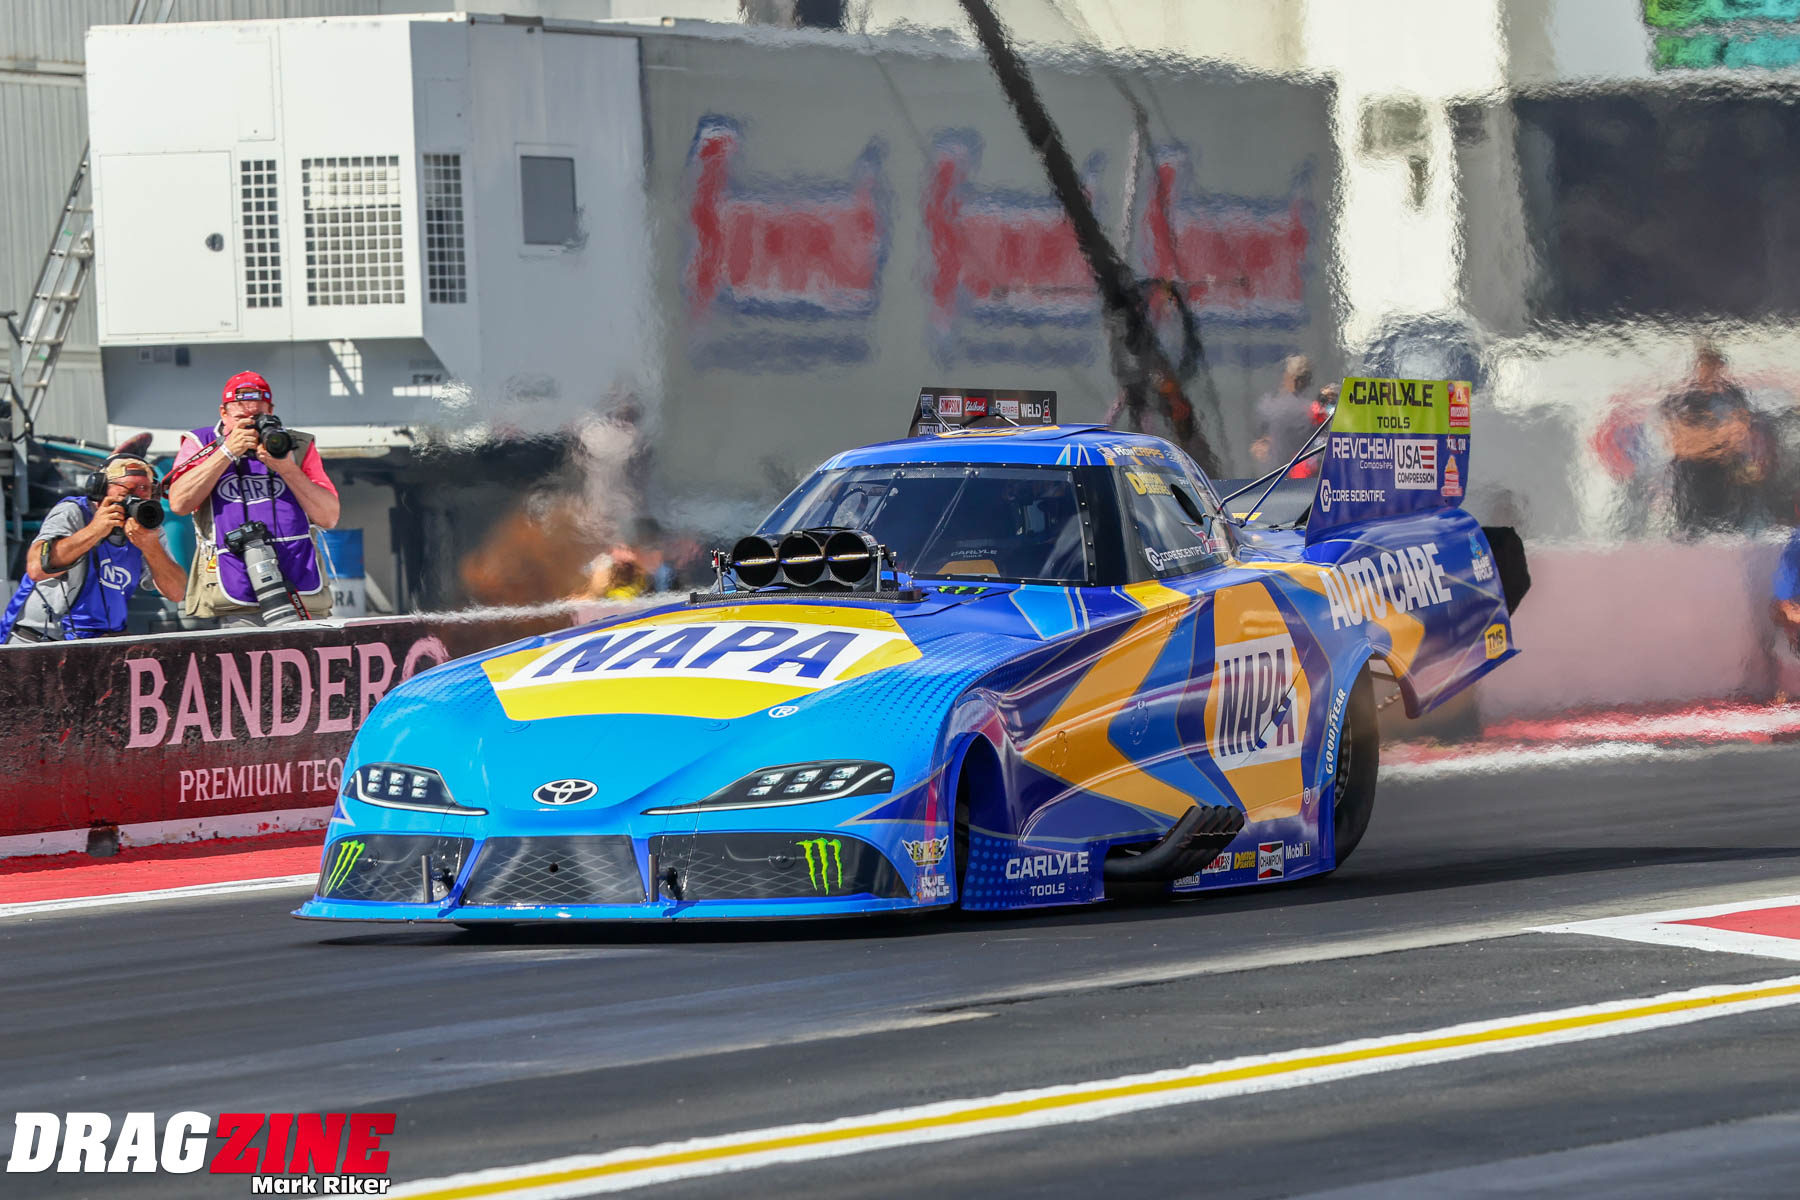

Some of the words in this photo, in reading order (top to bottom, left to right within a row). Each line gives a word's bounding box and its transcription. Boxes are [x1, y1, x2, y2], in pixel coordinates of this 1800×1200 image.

[1352, 381, 1434, 408] CARLYLE
[1020, 403, 1042, 418] WELD
[1377, 416, 1411, 429] TOOLS
[1332, 437, 1394, 460] REVCHEM
[1396, 445, 1422, 469] USA
[1397, 472, 1435, 484] COMPRESSION
[1332, 490, 1350, 502] CORE
[1350, 490, 1386, 502] SCIENTIFIC
[1318, 556, 1388, 631] AUTO
[1379, 542, 1453, 615] CARE
[531, 625, 860, 680] NAPA
[1218, 648, 1295, 757] NAPA
[1325, 688, 1347, 775] GOODYEAR
[178, 762, 294, 803] PREMIUM
[1260, 854, 1282, 868] CHAMPION
[1285, 843, 1304, 861] Mobil
[1304, 841, 1310, 857] 1
[1005, 851, 1089, 880] CARLYLE
[1030, 883, 1065, 897] TOOLS
